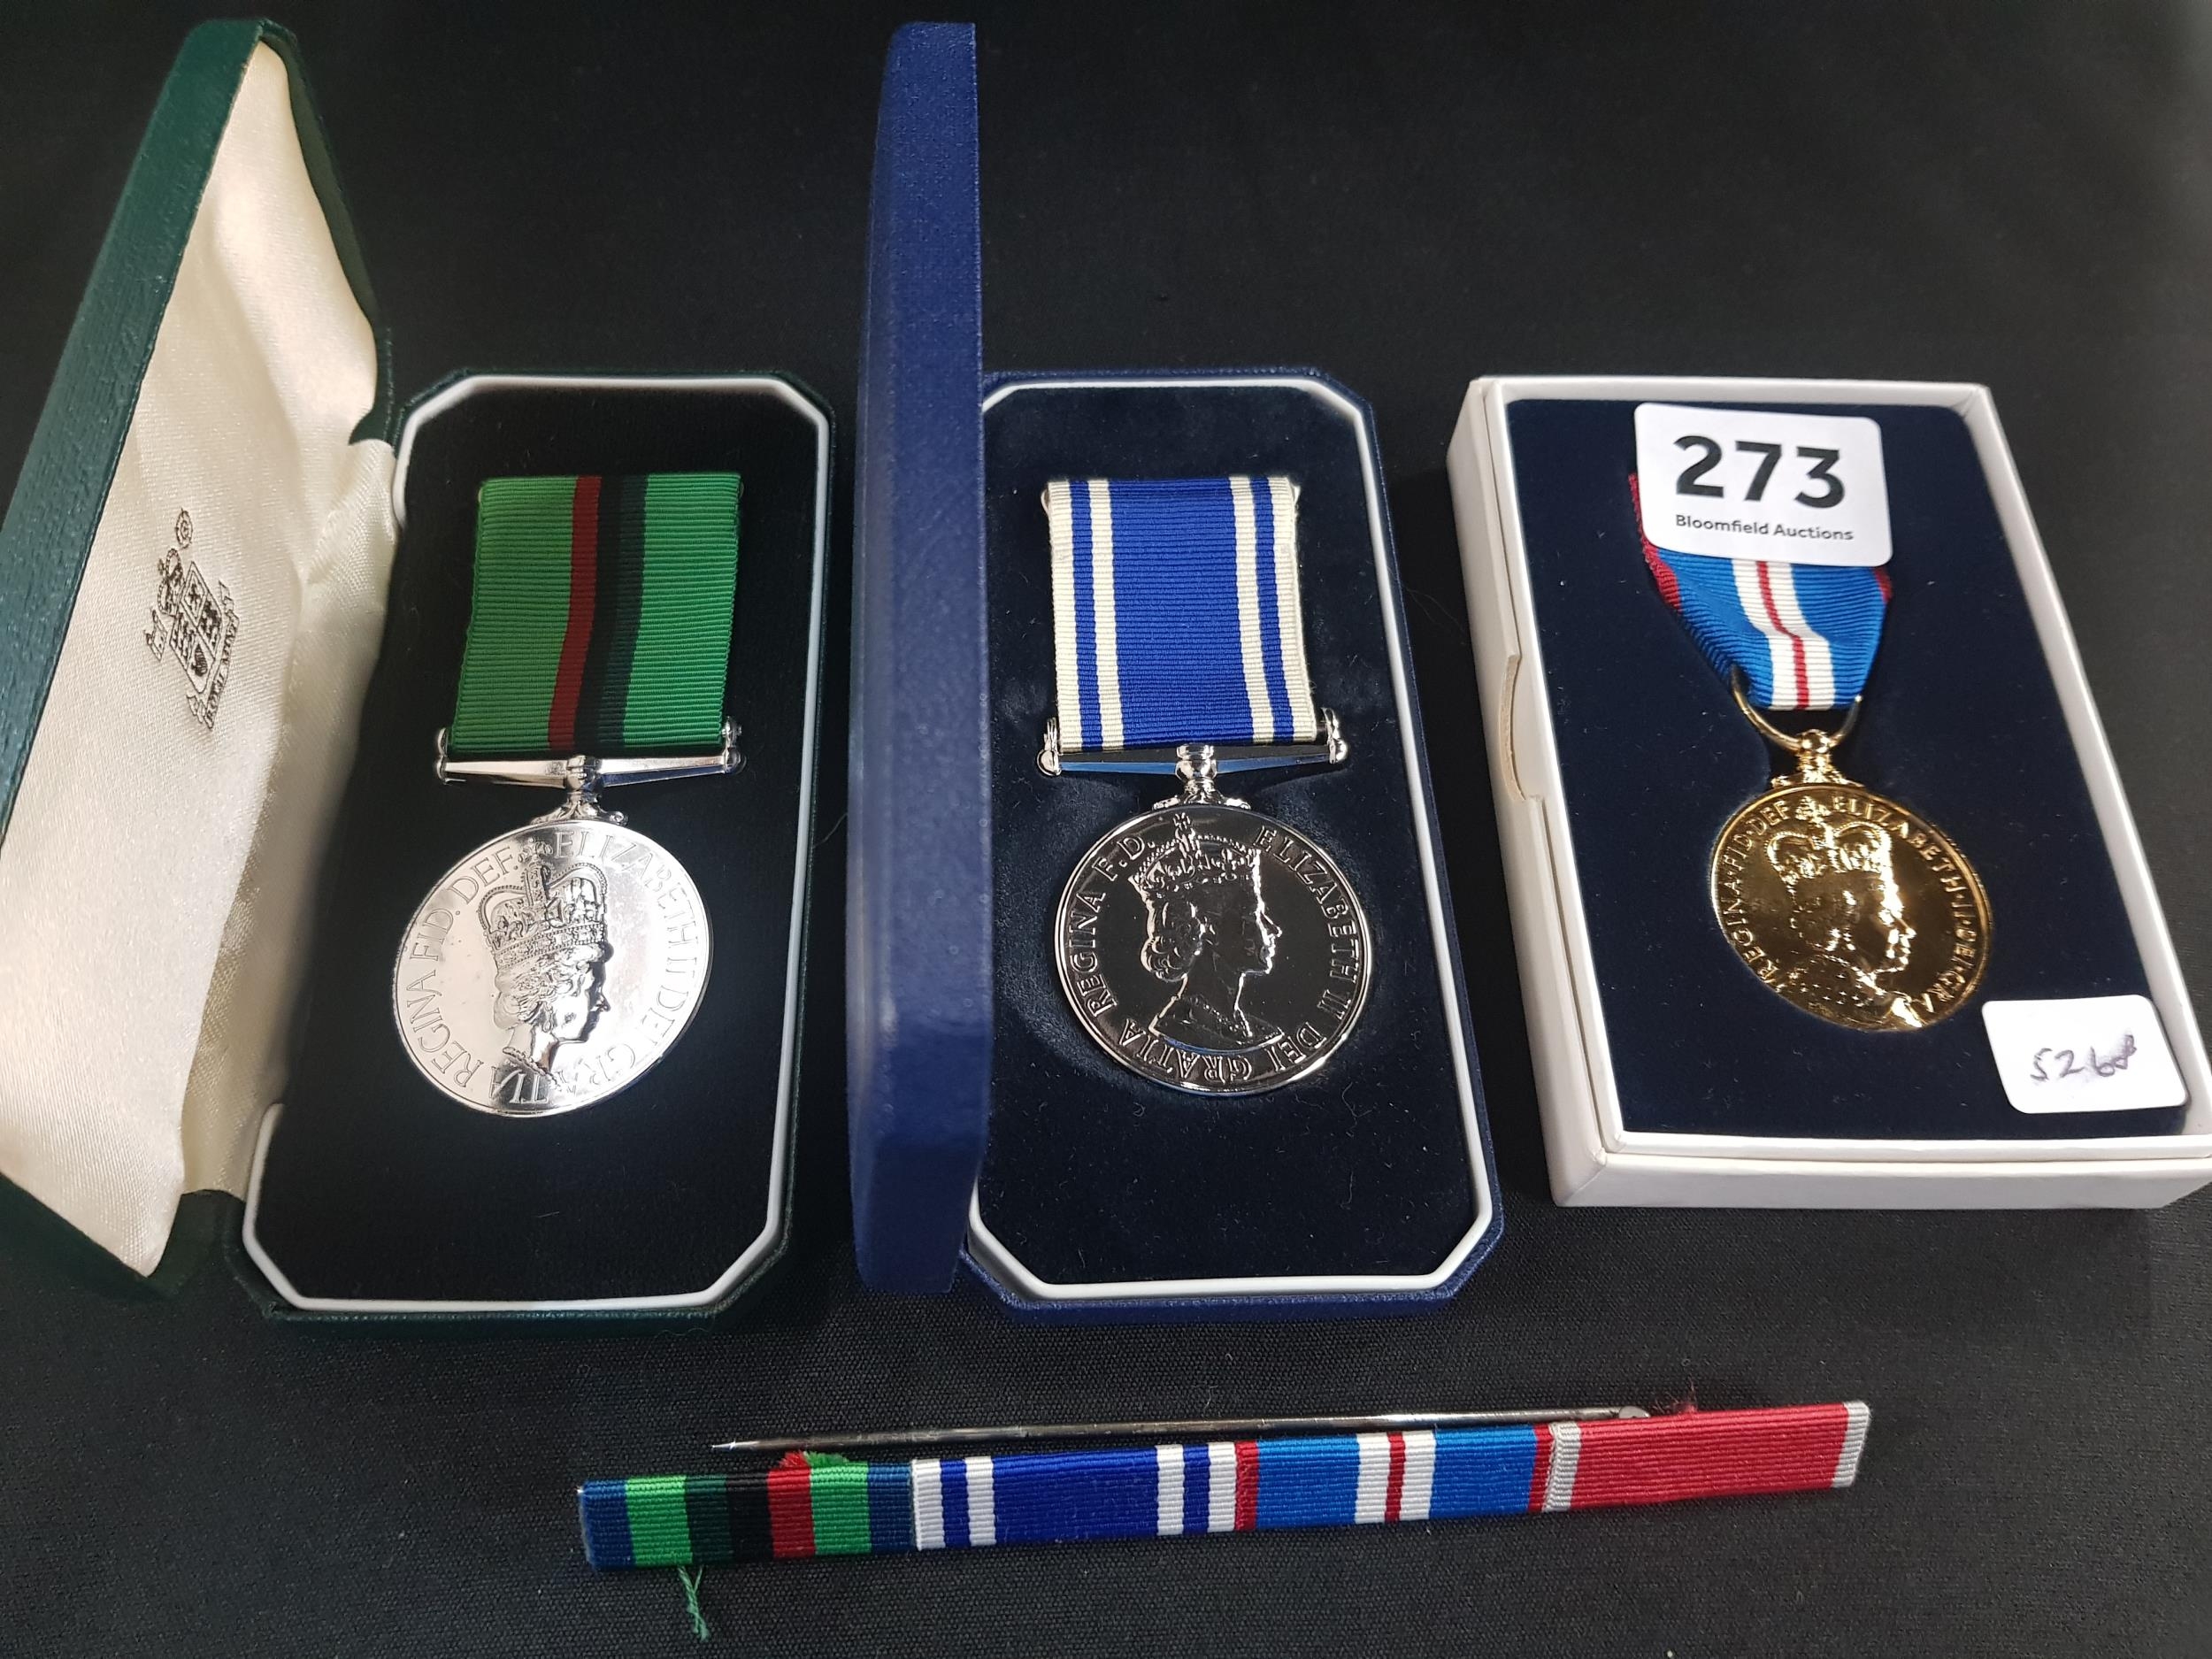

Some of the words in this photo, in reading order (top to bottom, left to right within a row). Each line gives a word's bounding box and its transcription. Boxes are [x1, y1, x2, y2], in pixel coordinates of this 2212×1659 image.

[1672, 434, 1846, 509] 273
[1676, 514, 1769, 535] Bloomfield
[1773, 524, 1855, 541] Auctions
[1253, 826, 1359, 984] ELIZABETH
[1068, 891, 1118, 1018] REGINA
[406, 971, 485, 1088] REGINA
[1118, 1019, 1254, 1084] GRATIA
